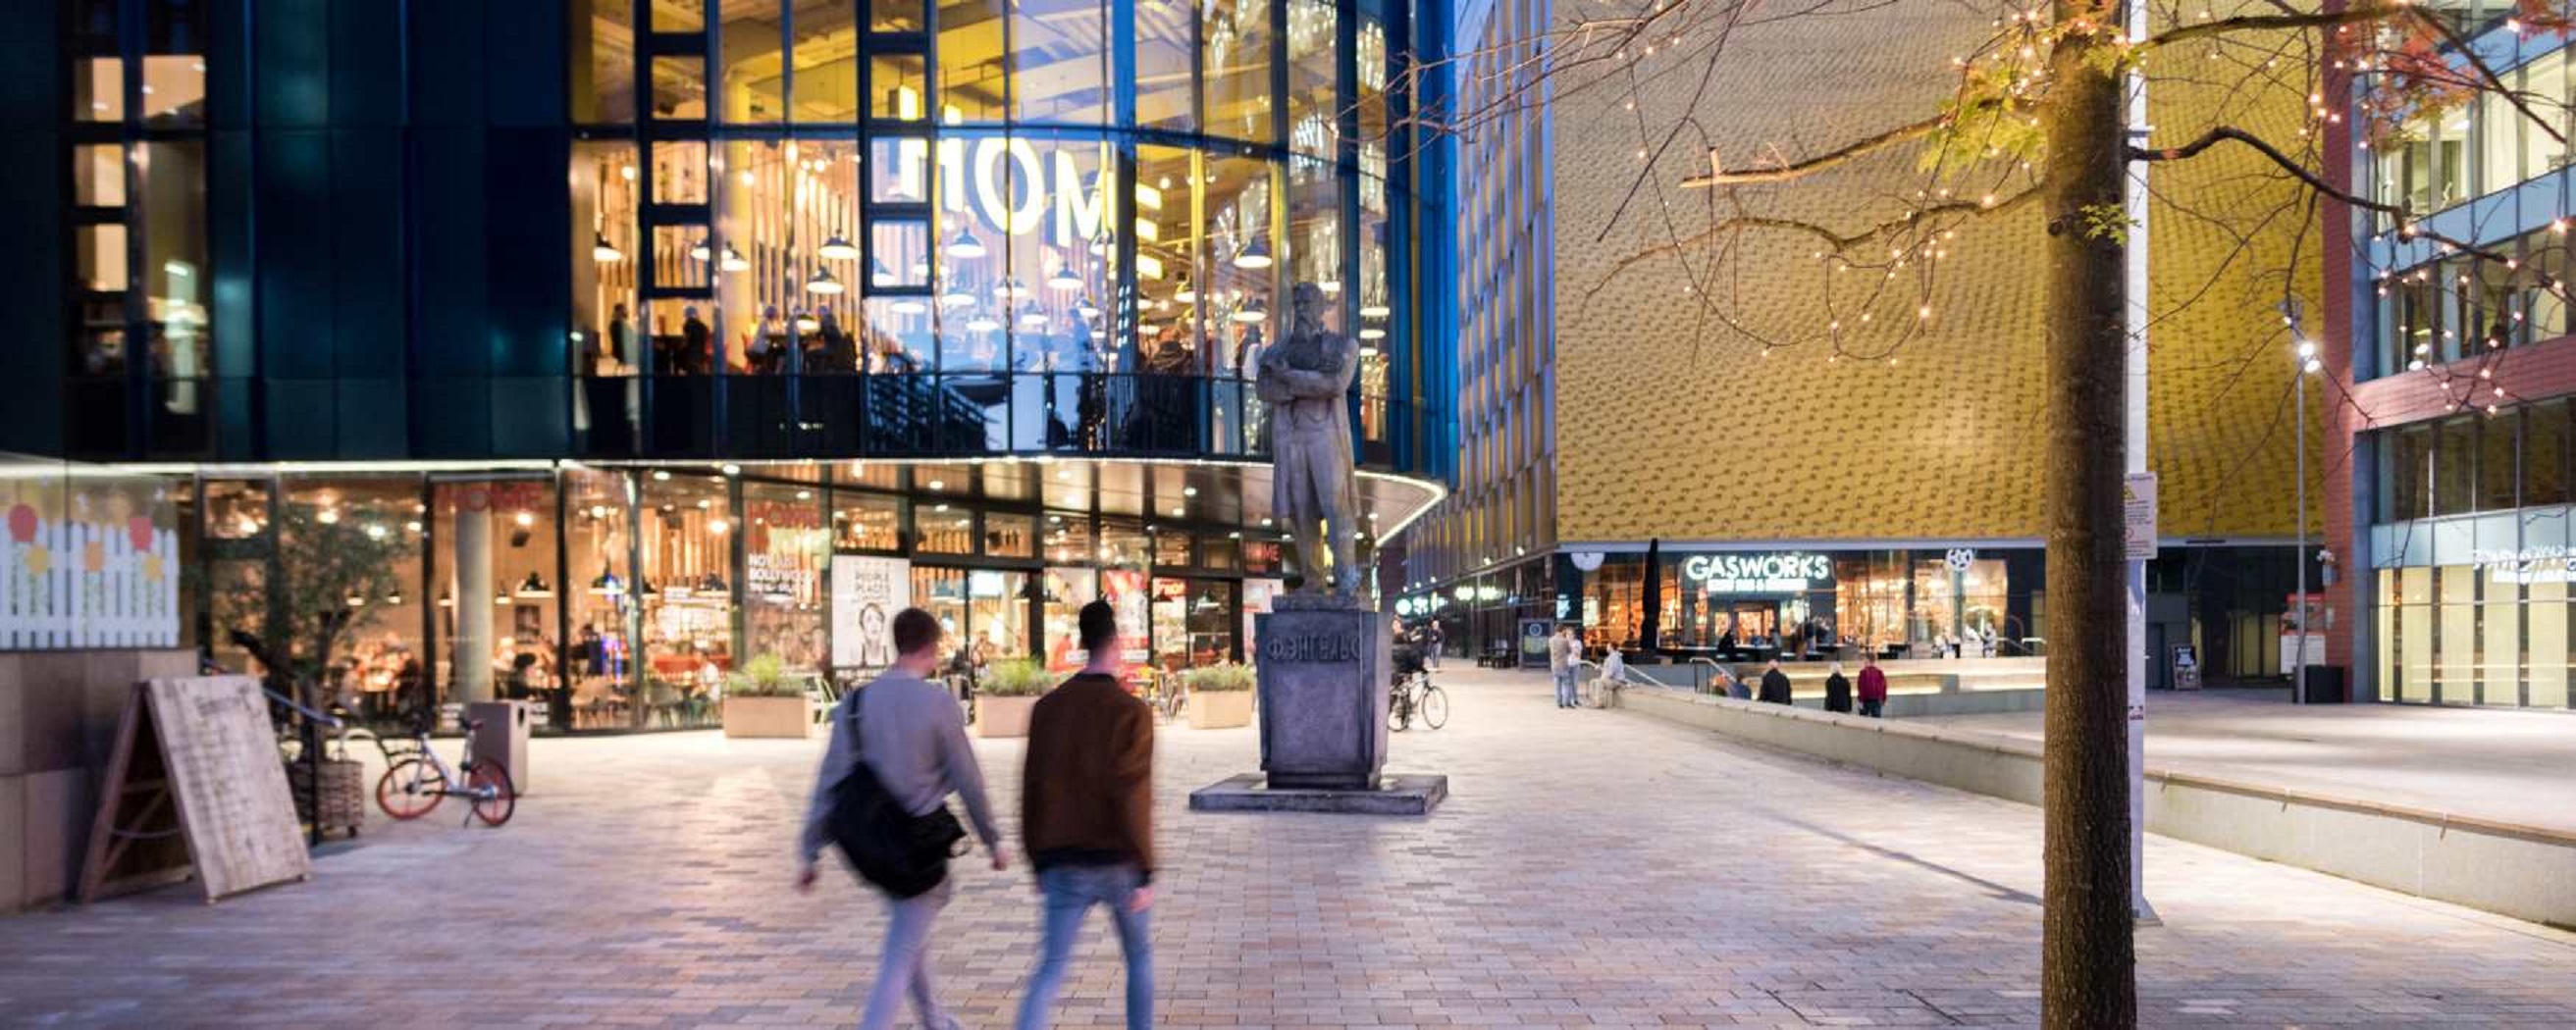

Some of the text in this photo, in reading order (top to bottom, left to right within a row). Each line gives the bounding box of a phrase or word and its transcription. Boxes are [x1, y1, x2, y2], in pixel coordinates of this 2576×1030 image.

[897, 84, 1163, 281] HOME
[434, 481, 543, 514] HOME
[1686, 555, 1829, 580] GASWORKS
